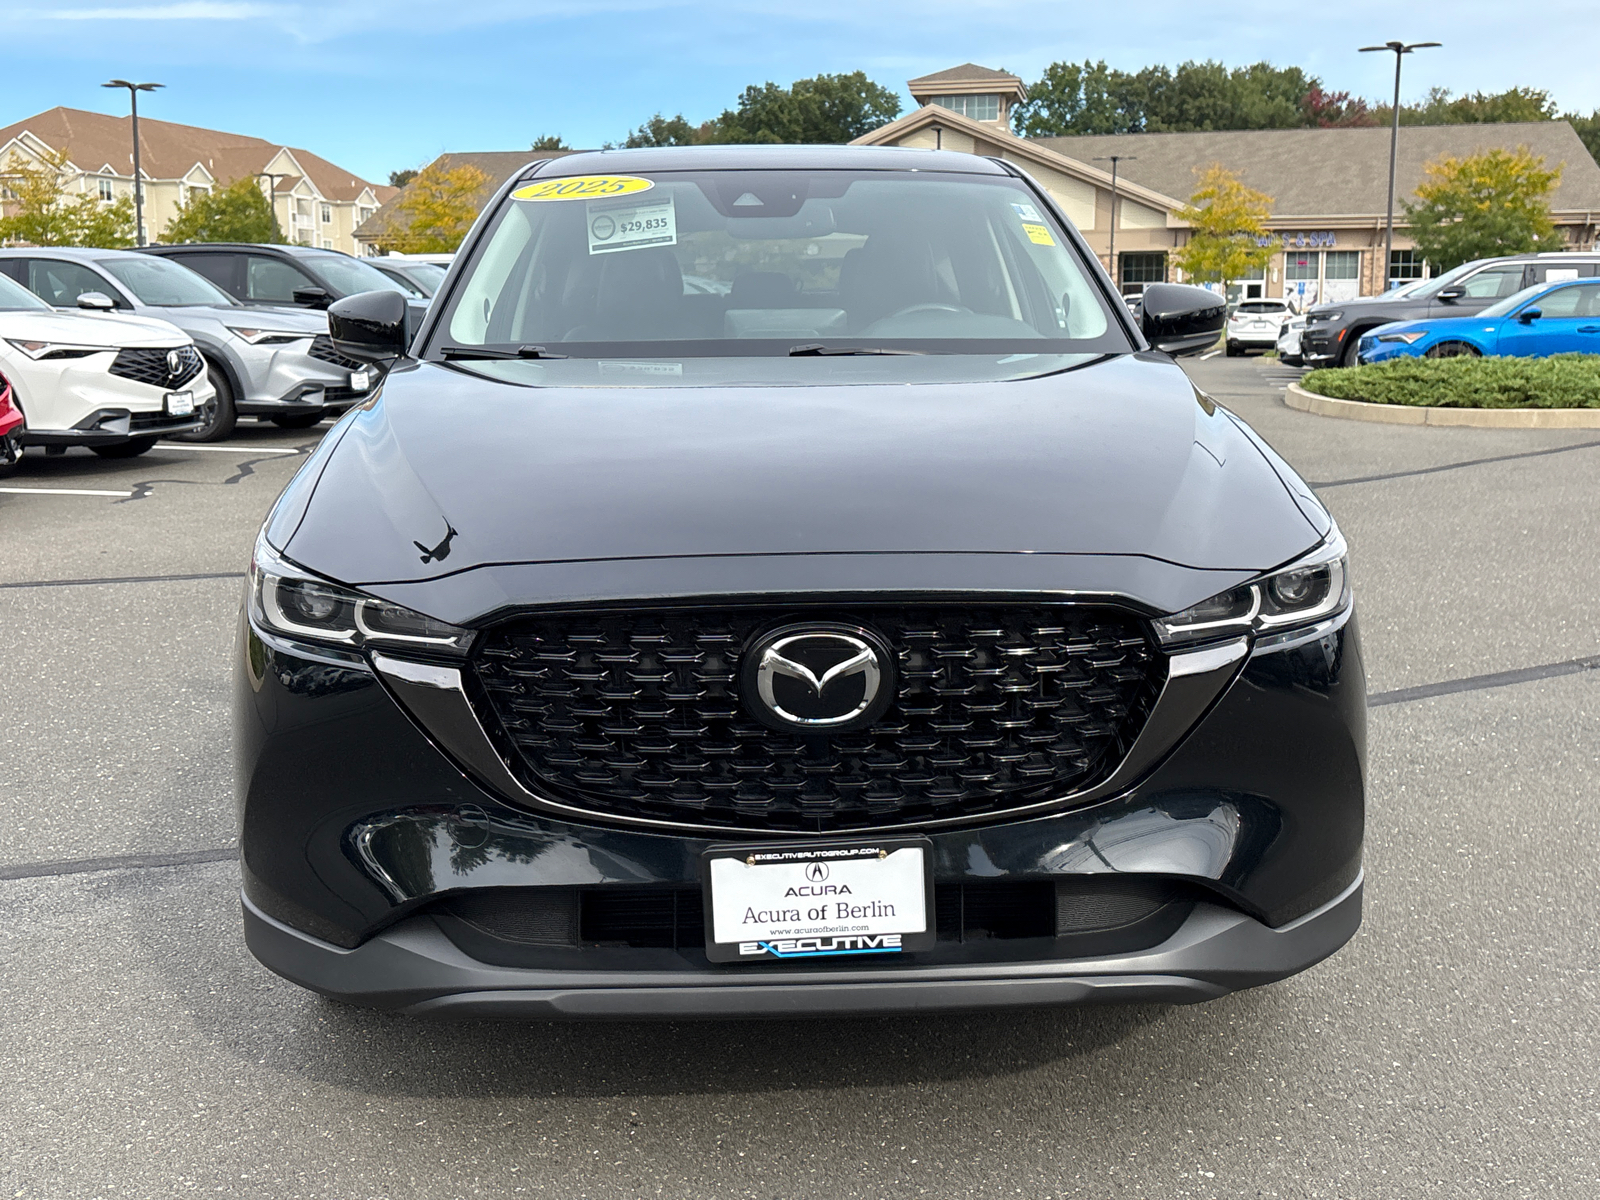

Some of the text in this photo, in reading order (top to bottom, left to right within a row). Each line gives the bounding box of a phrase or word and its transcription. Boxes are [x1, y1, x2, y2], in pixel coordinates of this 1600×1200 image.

[531, 180, 634, 198] 2025
[620, 217, 668, 235] $29,835
[1296, 231, 1306, 247] &
[1309, 231, 1337, 247] SPA
[754, 847, 880, 860] EXECUTIVEAUTOGROUP.COM
[784, 884, 852, 897] ACURA
[742, 900, 896, 924] Acura of Berlin
[769, 924, 870, 936] www.acuraofberlin.com
[739, 934, 902, 957] EXECUTIVE
